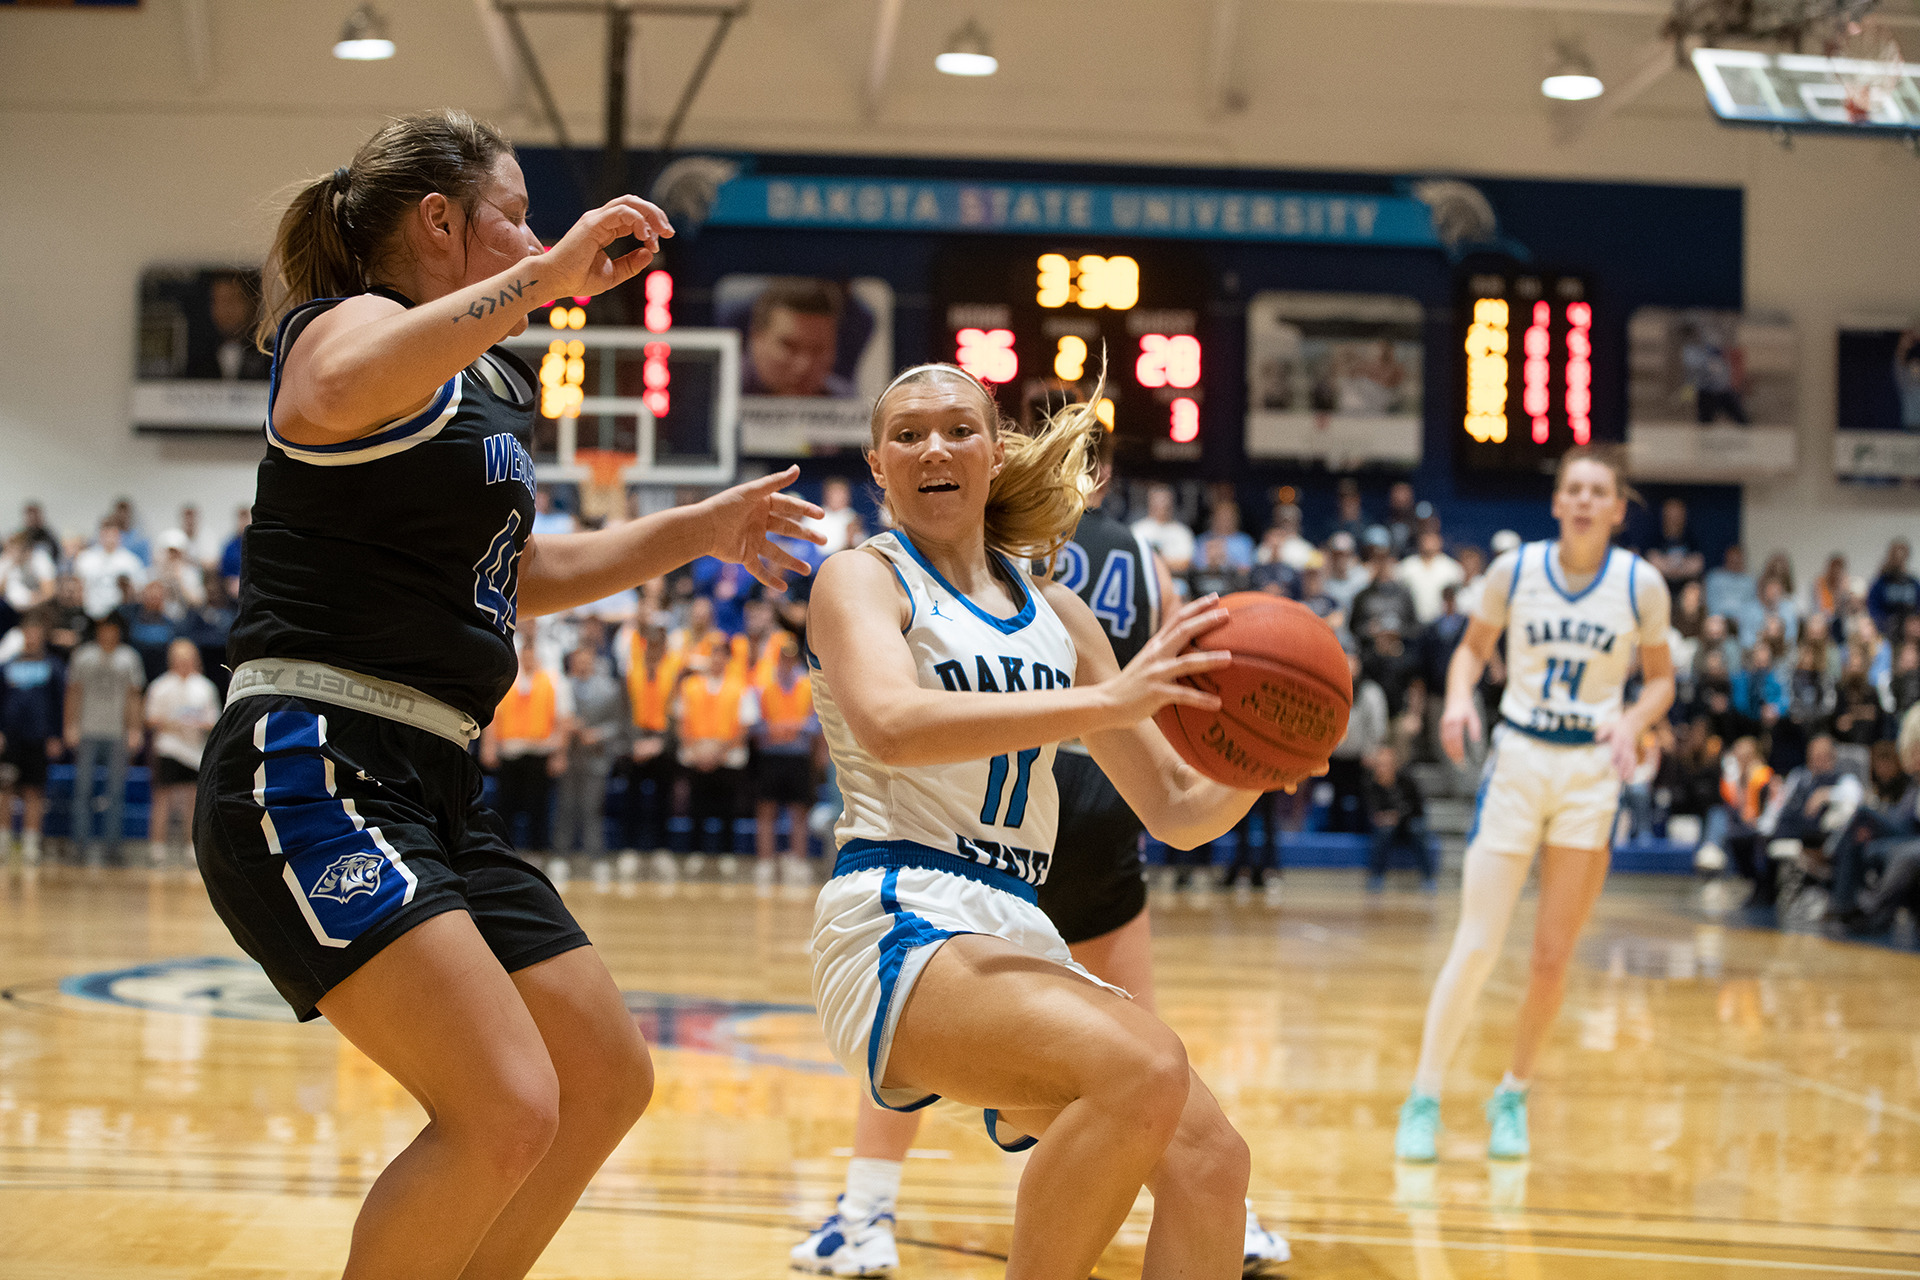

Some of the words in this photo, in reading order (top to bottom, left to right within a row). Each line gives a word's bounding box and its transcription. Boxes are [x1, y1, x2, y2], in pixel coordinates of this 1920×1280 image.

[767, 180, 941, 223] DAKOTA
[959, 186, 1091, 230] STATE
[1111, 192, 1379, 238] UNIVERSITY
[1046, 541, 1137, 639] 24
[1526, 619, 1616, 653] DAKOTA
[295, 671, 418, 714] UNDER
[1542, 658, 1588, 701] 14
[979, 746, 1041, 829] 11
